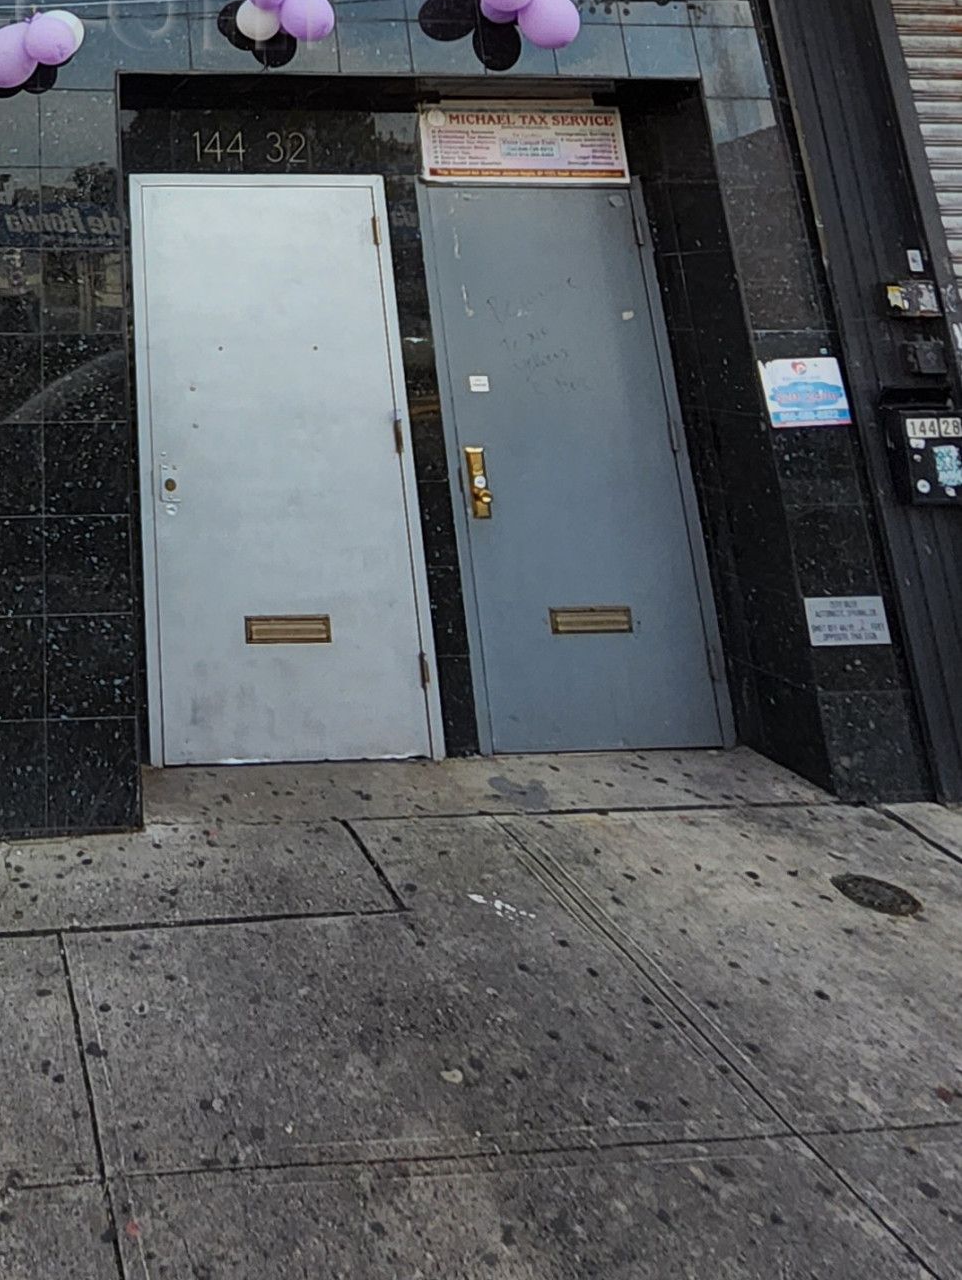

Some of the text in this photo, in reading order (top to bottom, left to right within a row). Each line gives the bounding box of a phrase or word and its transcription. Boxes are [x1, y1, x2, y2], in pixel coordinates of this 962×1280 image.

[448, 113, 516, 126] MICHAEL
[519, 114, 549, 126] TAX
[551, 114, 615, 128] SERVICE
[191, 129, 309, 163] 144 32
[910, 420, 960, 436] 144 28
